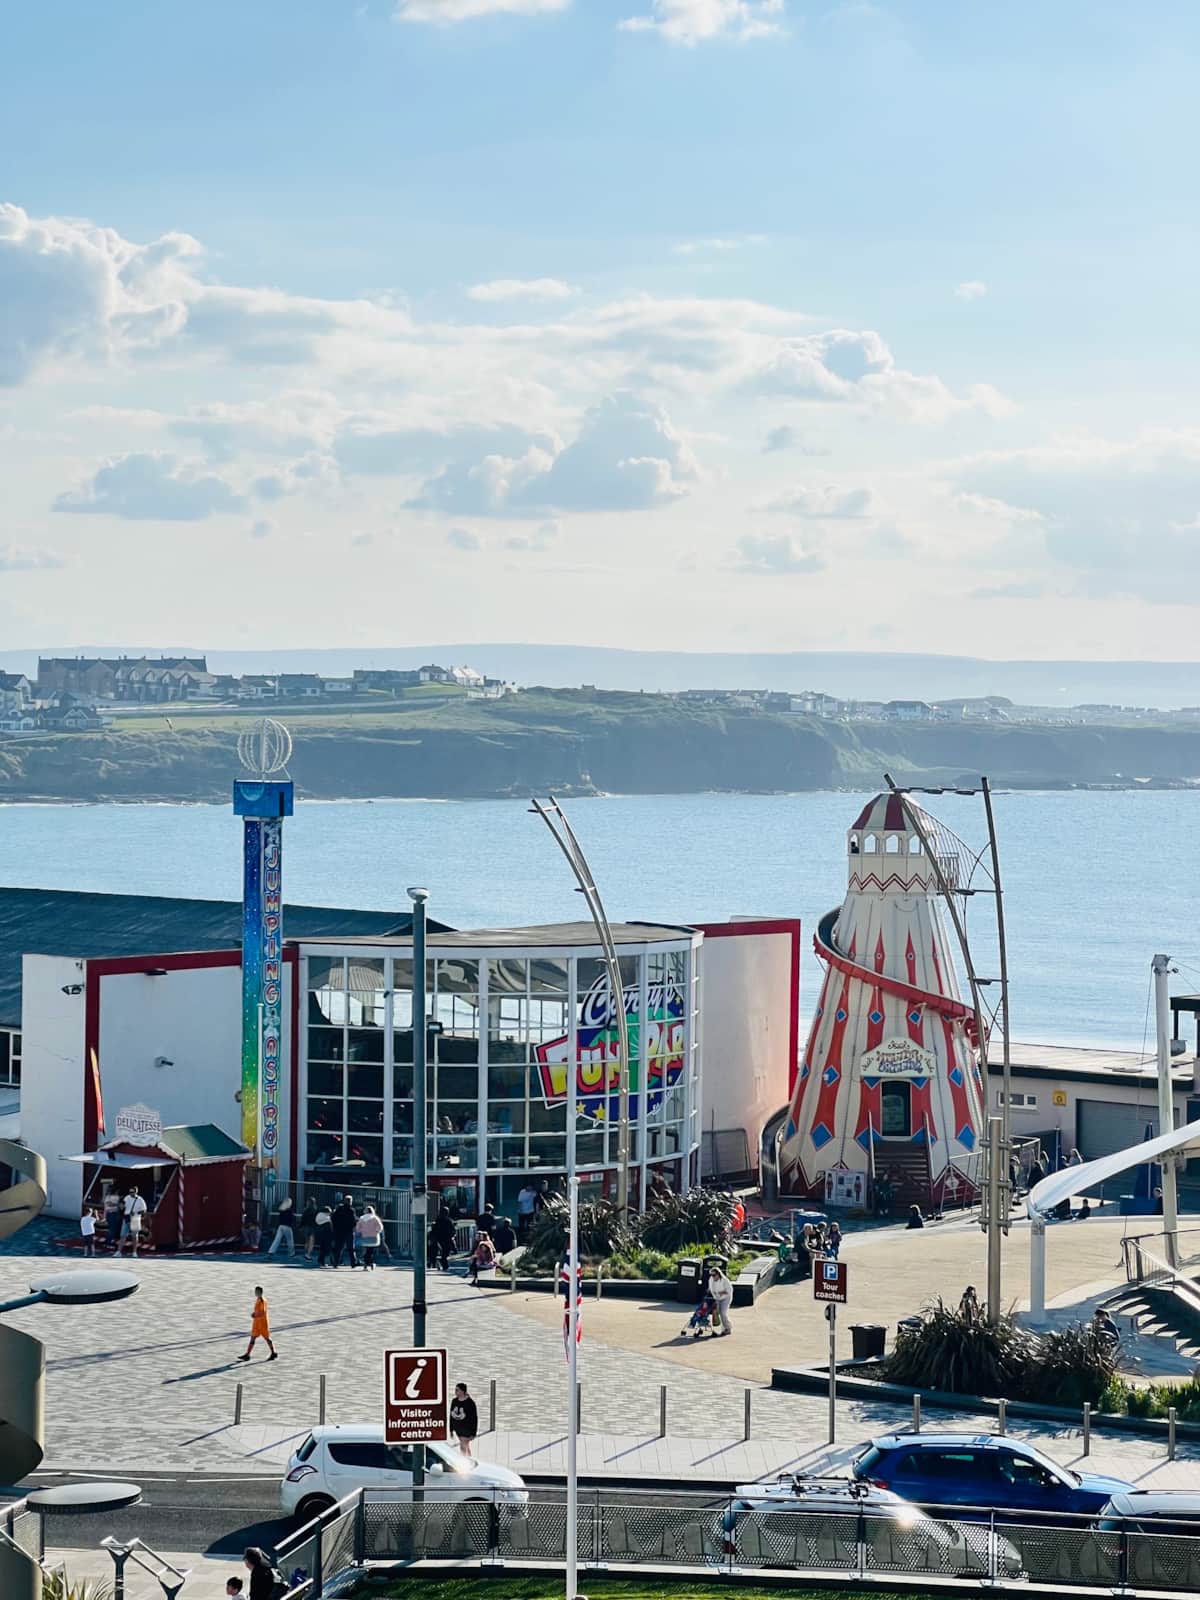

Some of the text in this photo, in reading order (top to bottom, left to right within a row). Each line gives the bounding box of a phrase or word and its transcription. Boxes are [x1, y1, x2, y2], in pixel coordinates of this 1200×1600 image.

[263, 847, 281, 1149] JUMPING ASTRO
[545, 1041, 626, 1095] FUN
[826, 1265, 836, 1278] P
[822, 1282, 839, 1291] Tour
[815, 1291, 845, 1301] coaches
[400, 1408, 432, 1418] Visitor
[400, 1430, 432, 1439] centre
